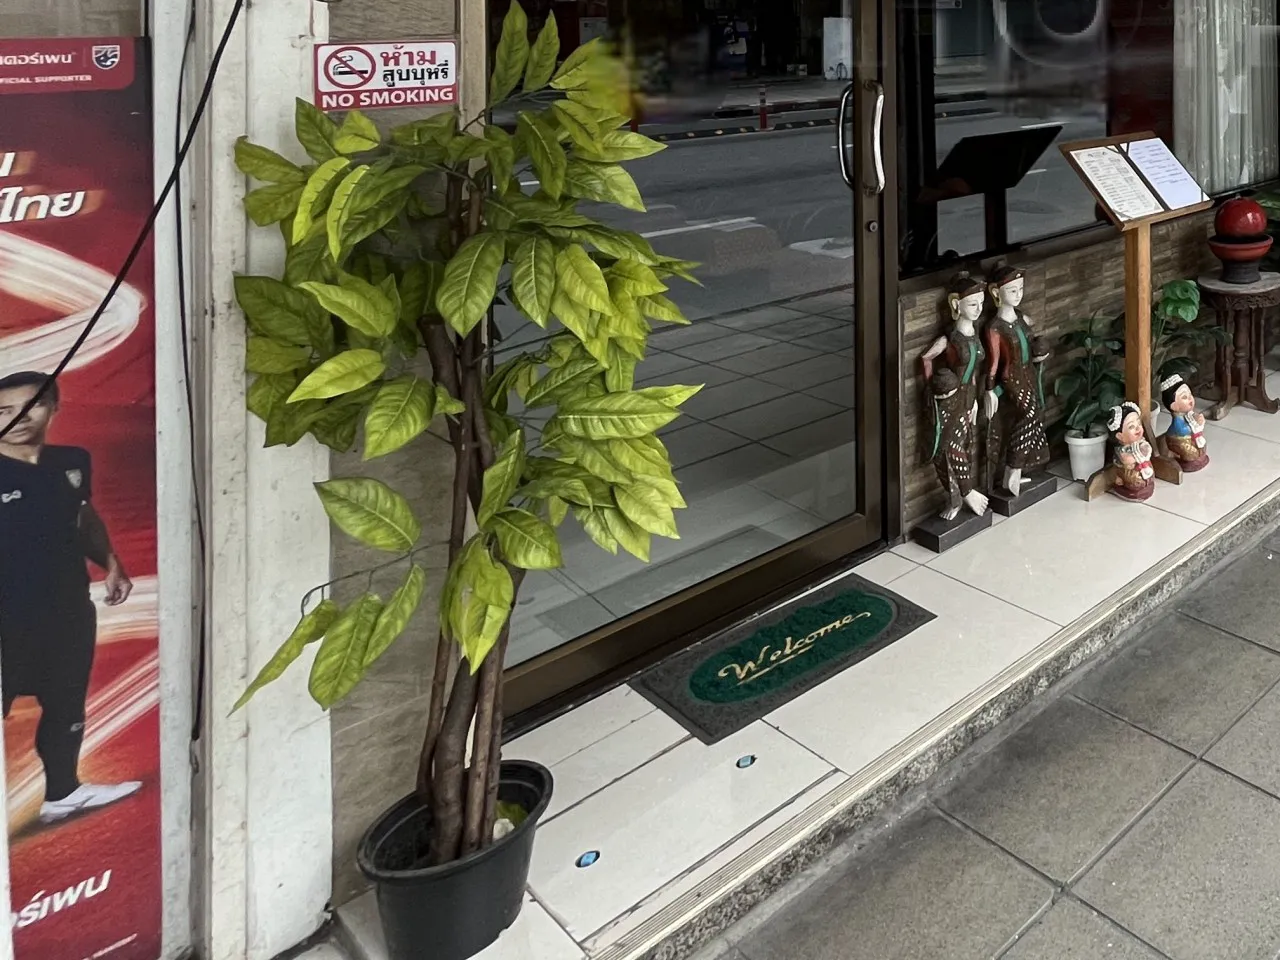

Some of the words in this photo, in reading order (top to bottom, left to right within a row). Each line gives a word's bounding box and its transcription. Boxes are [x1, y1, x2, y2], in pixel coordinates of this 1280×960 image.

[380, 44, 437, 67] ห้าม
[382, 60, 449, 88] สูบบุหรี่
[322, 93, 355, 108] NO
[359, 88, 454, 106] SMOKING
[717, 611, 872, 681] Welcome
